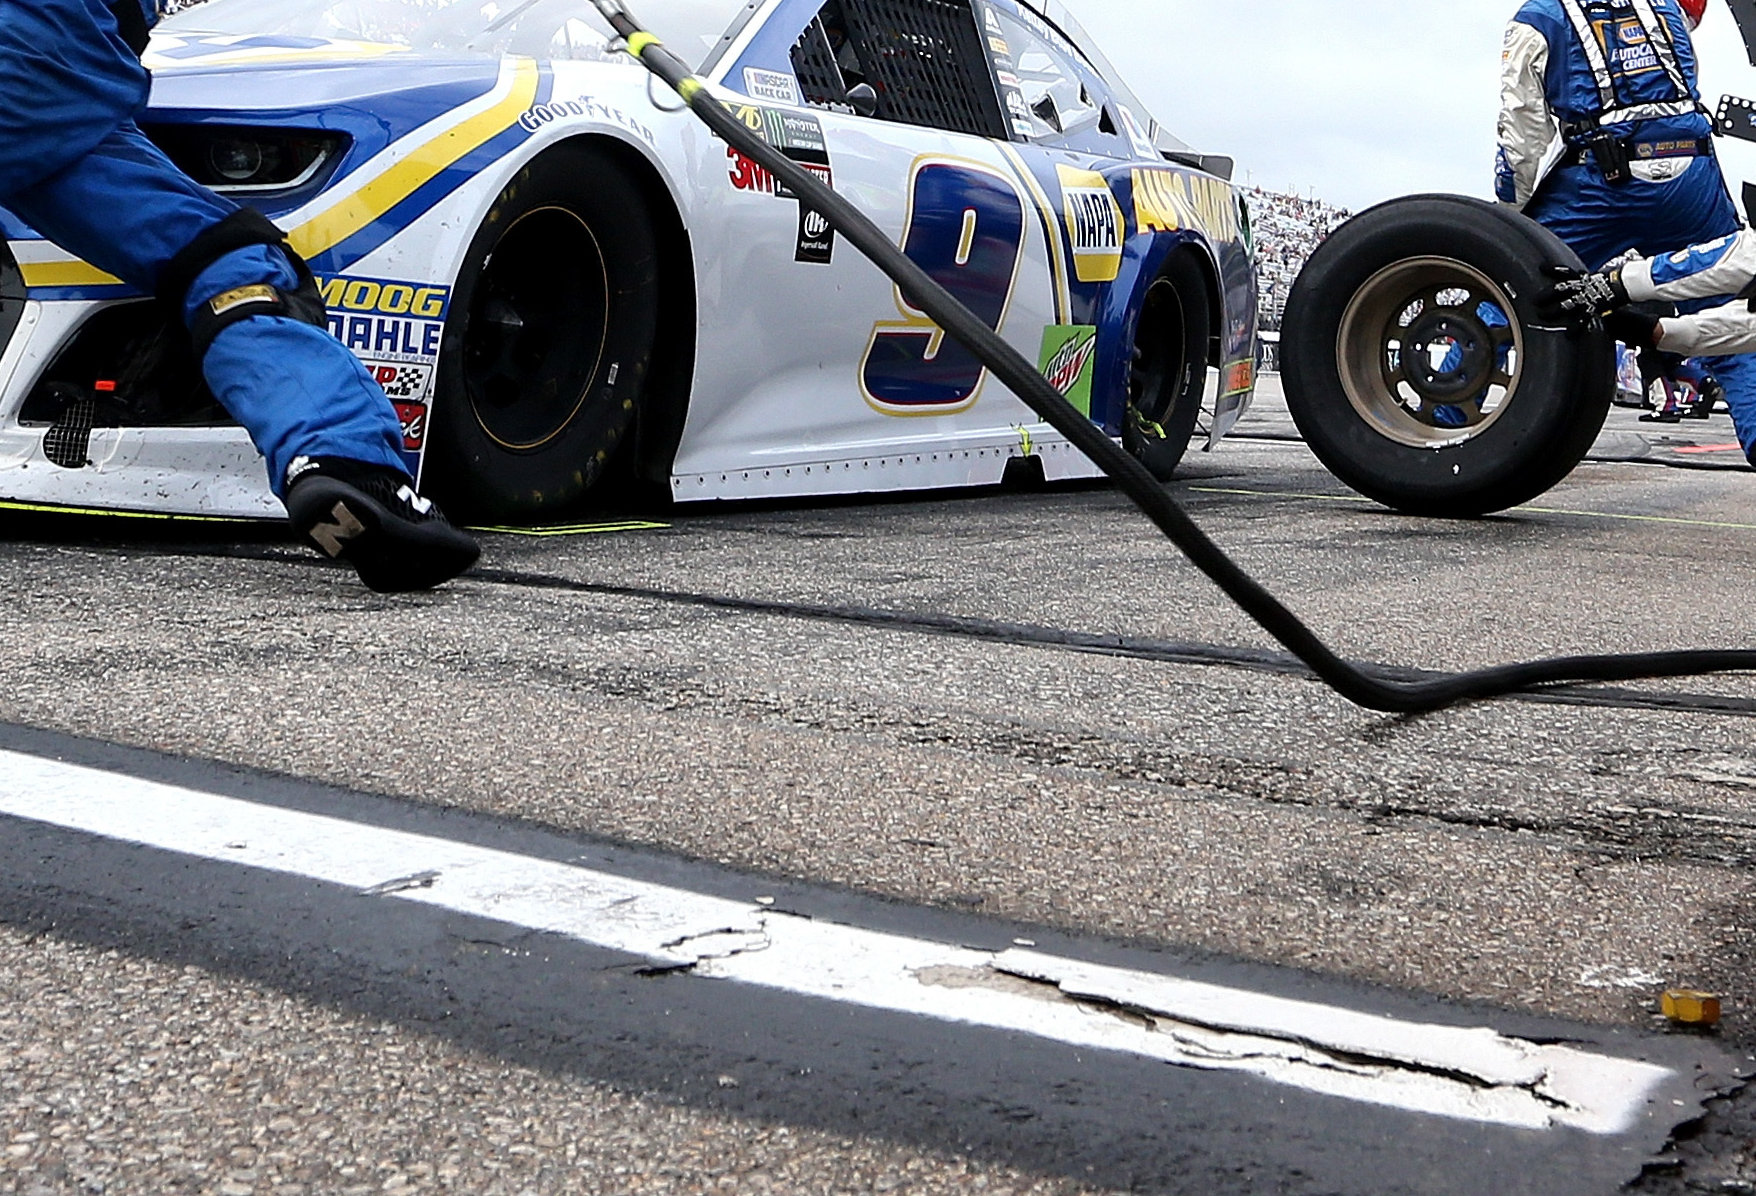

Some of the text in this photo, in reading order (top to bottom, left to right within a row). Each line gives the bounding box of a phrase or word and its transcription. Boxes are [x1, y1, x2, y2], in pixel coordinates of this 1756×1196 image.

[1611, 44, 1654, 63] AUTOCA
[1623, 56, 1657, 71] CENTER
[1069, 193, 1117, 247] NAPA
[1131, 168, 1206, 235] AUTO
[314, 276, 446, 317] MOOG
[858, 152, 1026, 416] 9
